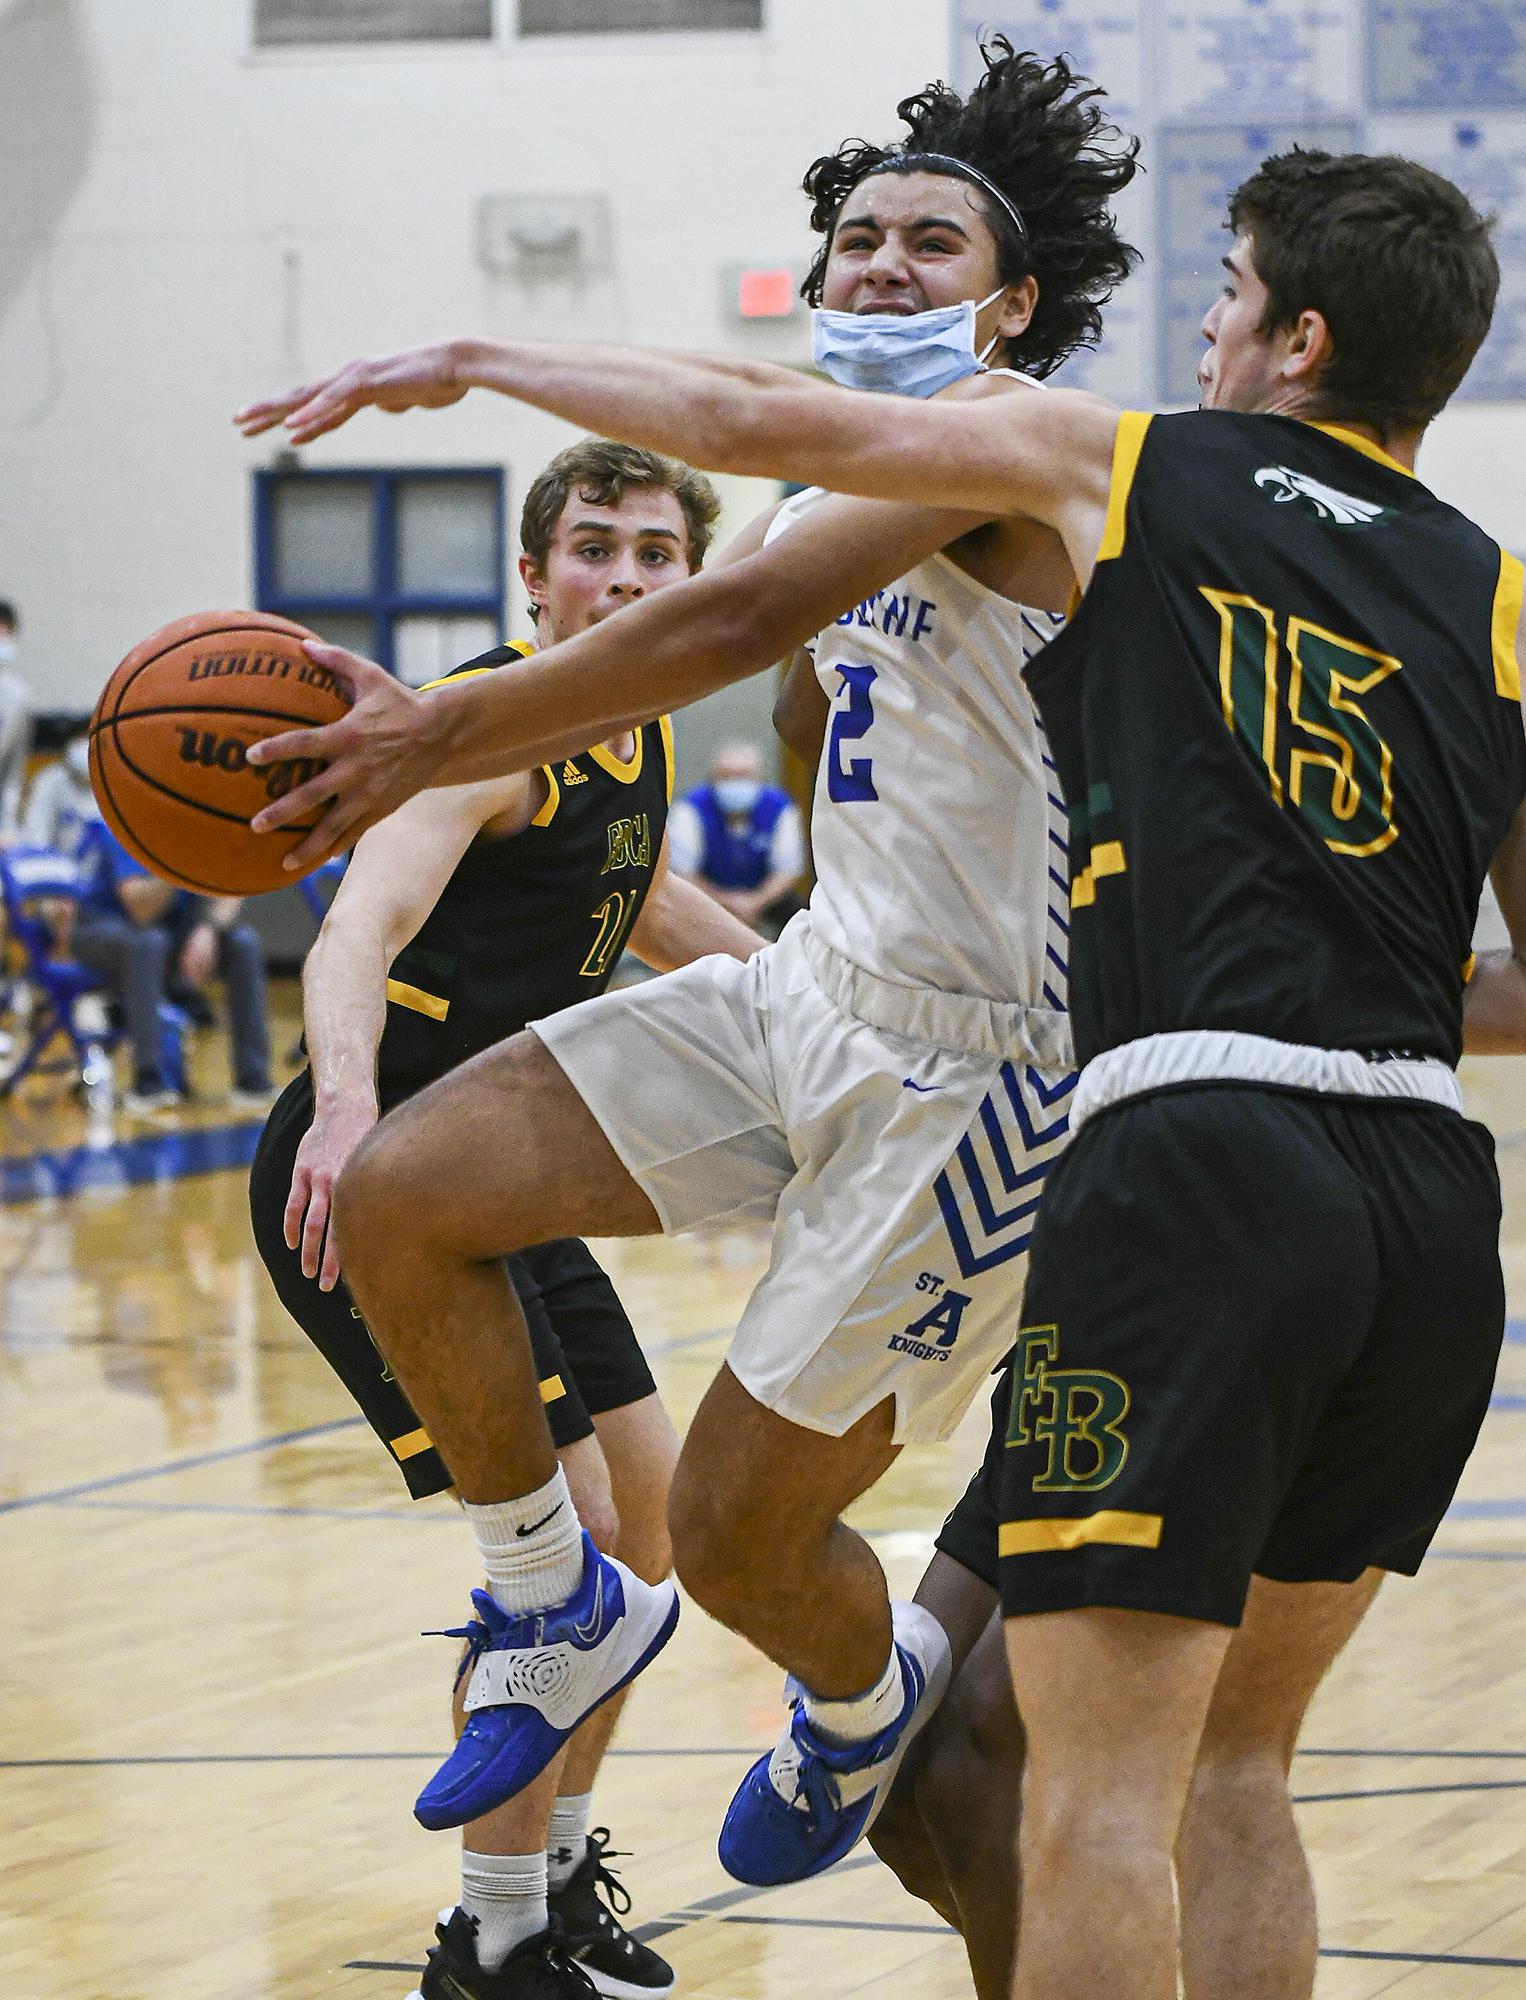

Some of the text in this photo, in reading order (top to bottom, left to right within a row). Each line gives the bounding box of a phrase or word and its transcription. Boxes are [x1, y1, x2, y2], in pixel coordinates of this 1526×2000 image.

[827, 663, 879, 803] 2
[1197, 585, 1404, 858] 15
[904, 1289, 973, 1348] A
[915, 1272, 945, 1296] ST.
[887, 1333, 952, 1362] KNIGHTS
[1004, 1323, 1132, 1492] FB
